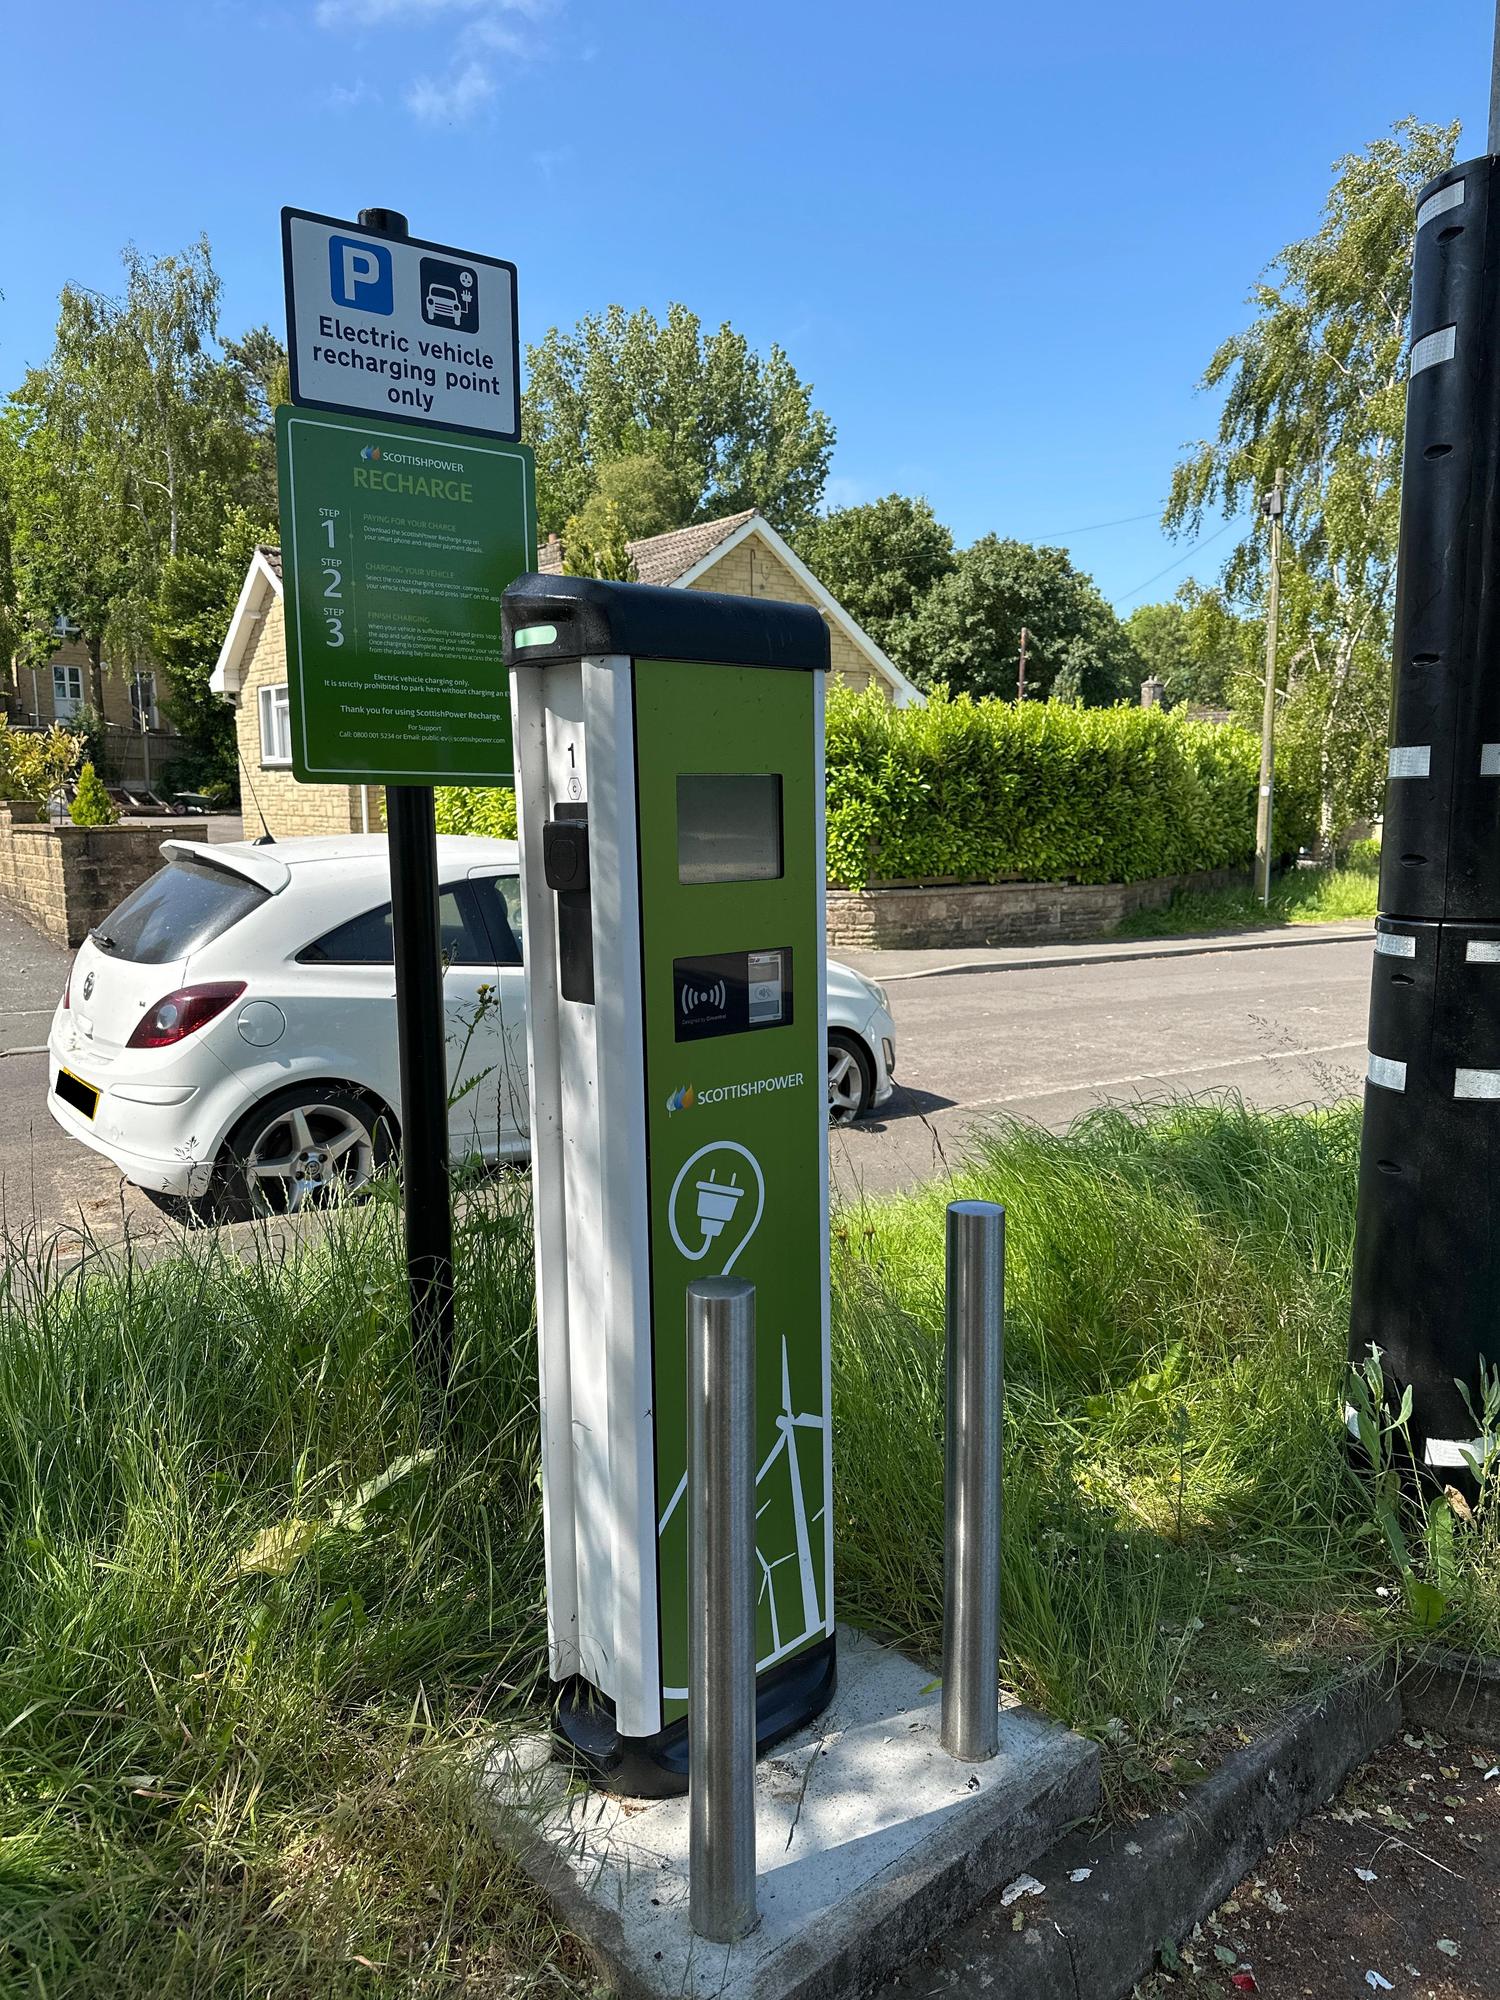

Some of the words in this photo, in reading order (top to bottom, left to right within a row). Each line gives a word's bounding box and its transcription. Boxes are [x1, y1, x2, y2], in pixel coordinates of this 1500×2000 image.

[342, 245, 380, 301] P
[319, 315, 409, 353] Electric
[418, 340, 494, 370] vehicle
[313, 345, 436, 387] recharging
[446, 371, 500, 395] point
[387, 386, 434, 412] only
[383, 451, 464, 473] SCOTTISHPOWER
[353, 467, 473, 503] RECHARGE
[318, 507, 340, 518] STEP
[363, 525, 391, 535] Download
[391, 517, 406, 526] FOR
[407, 519, 428, 529] YOUR
[321, 519, 335, 549] 1
[321, 557, 343, 568] STEP
[365, 562, 404, 574] CHARGING
[405, 567, 425, 577] YOUR
[426, 569, 455, 579] VEHICLE
[322, 568, 343, 599] 2
[323, 607, 345, 617] STEP
[367, 611, 392, 621] FINISH
[392, 613, 430, 624] CHARGING
[325, 618, 345, 647] 3
[324, 679, 330, 687] It
[331, 679, 337, 687] is
[338, 680, 363, 690] strictly
[363, 682, 400, 691] prohibited
[409, 685, 425, 693] park
[441, 686, 467, 695] without
[467, 689, 495, 698] charging
[373, 673, 399, 682] Electric
[400, 675, 424, 684] vehicle
[425, 677, 453, 687] charging
[454, 679, 470, 688] only.
[340, 705, 365, 714] Thank
[366, 707, 381, 716] you
[382, 706, 394, 715] for
[394, 708, 415, 718] using
[416, 709, 467, 719] ScottishPower
[468, 711, 503, 722] Recharge.
[353, 731, 368, 739] 0800
[380, 732, 395, 740] 5234
[418, 724, 442, 732] Support
[567, 743, 575, 768] 1
[697, 1072, 804, 1105] SCOTTISHPOWER
